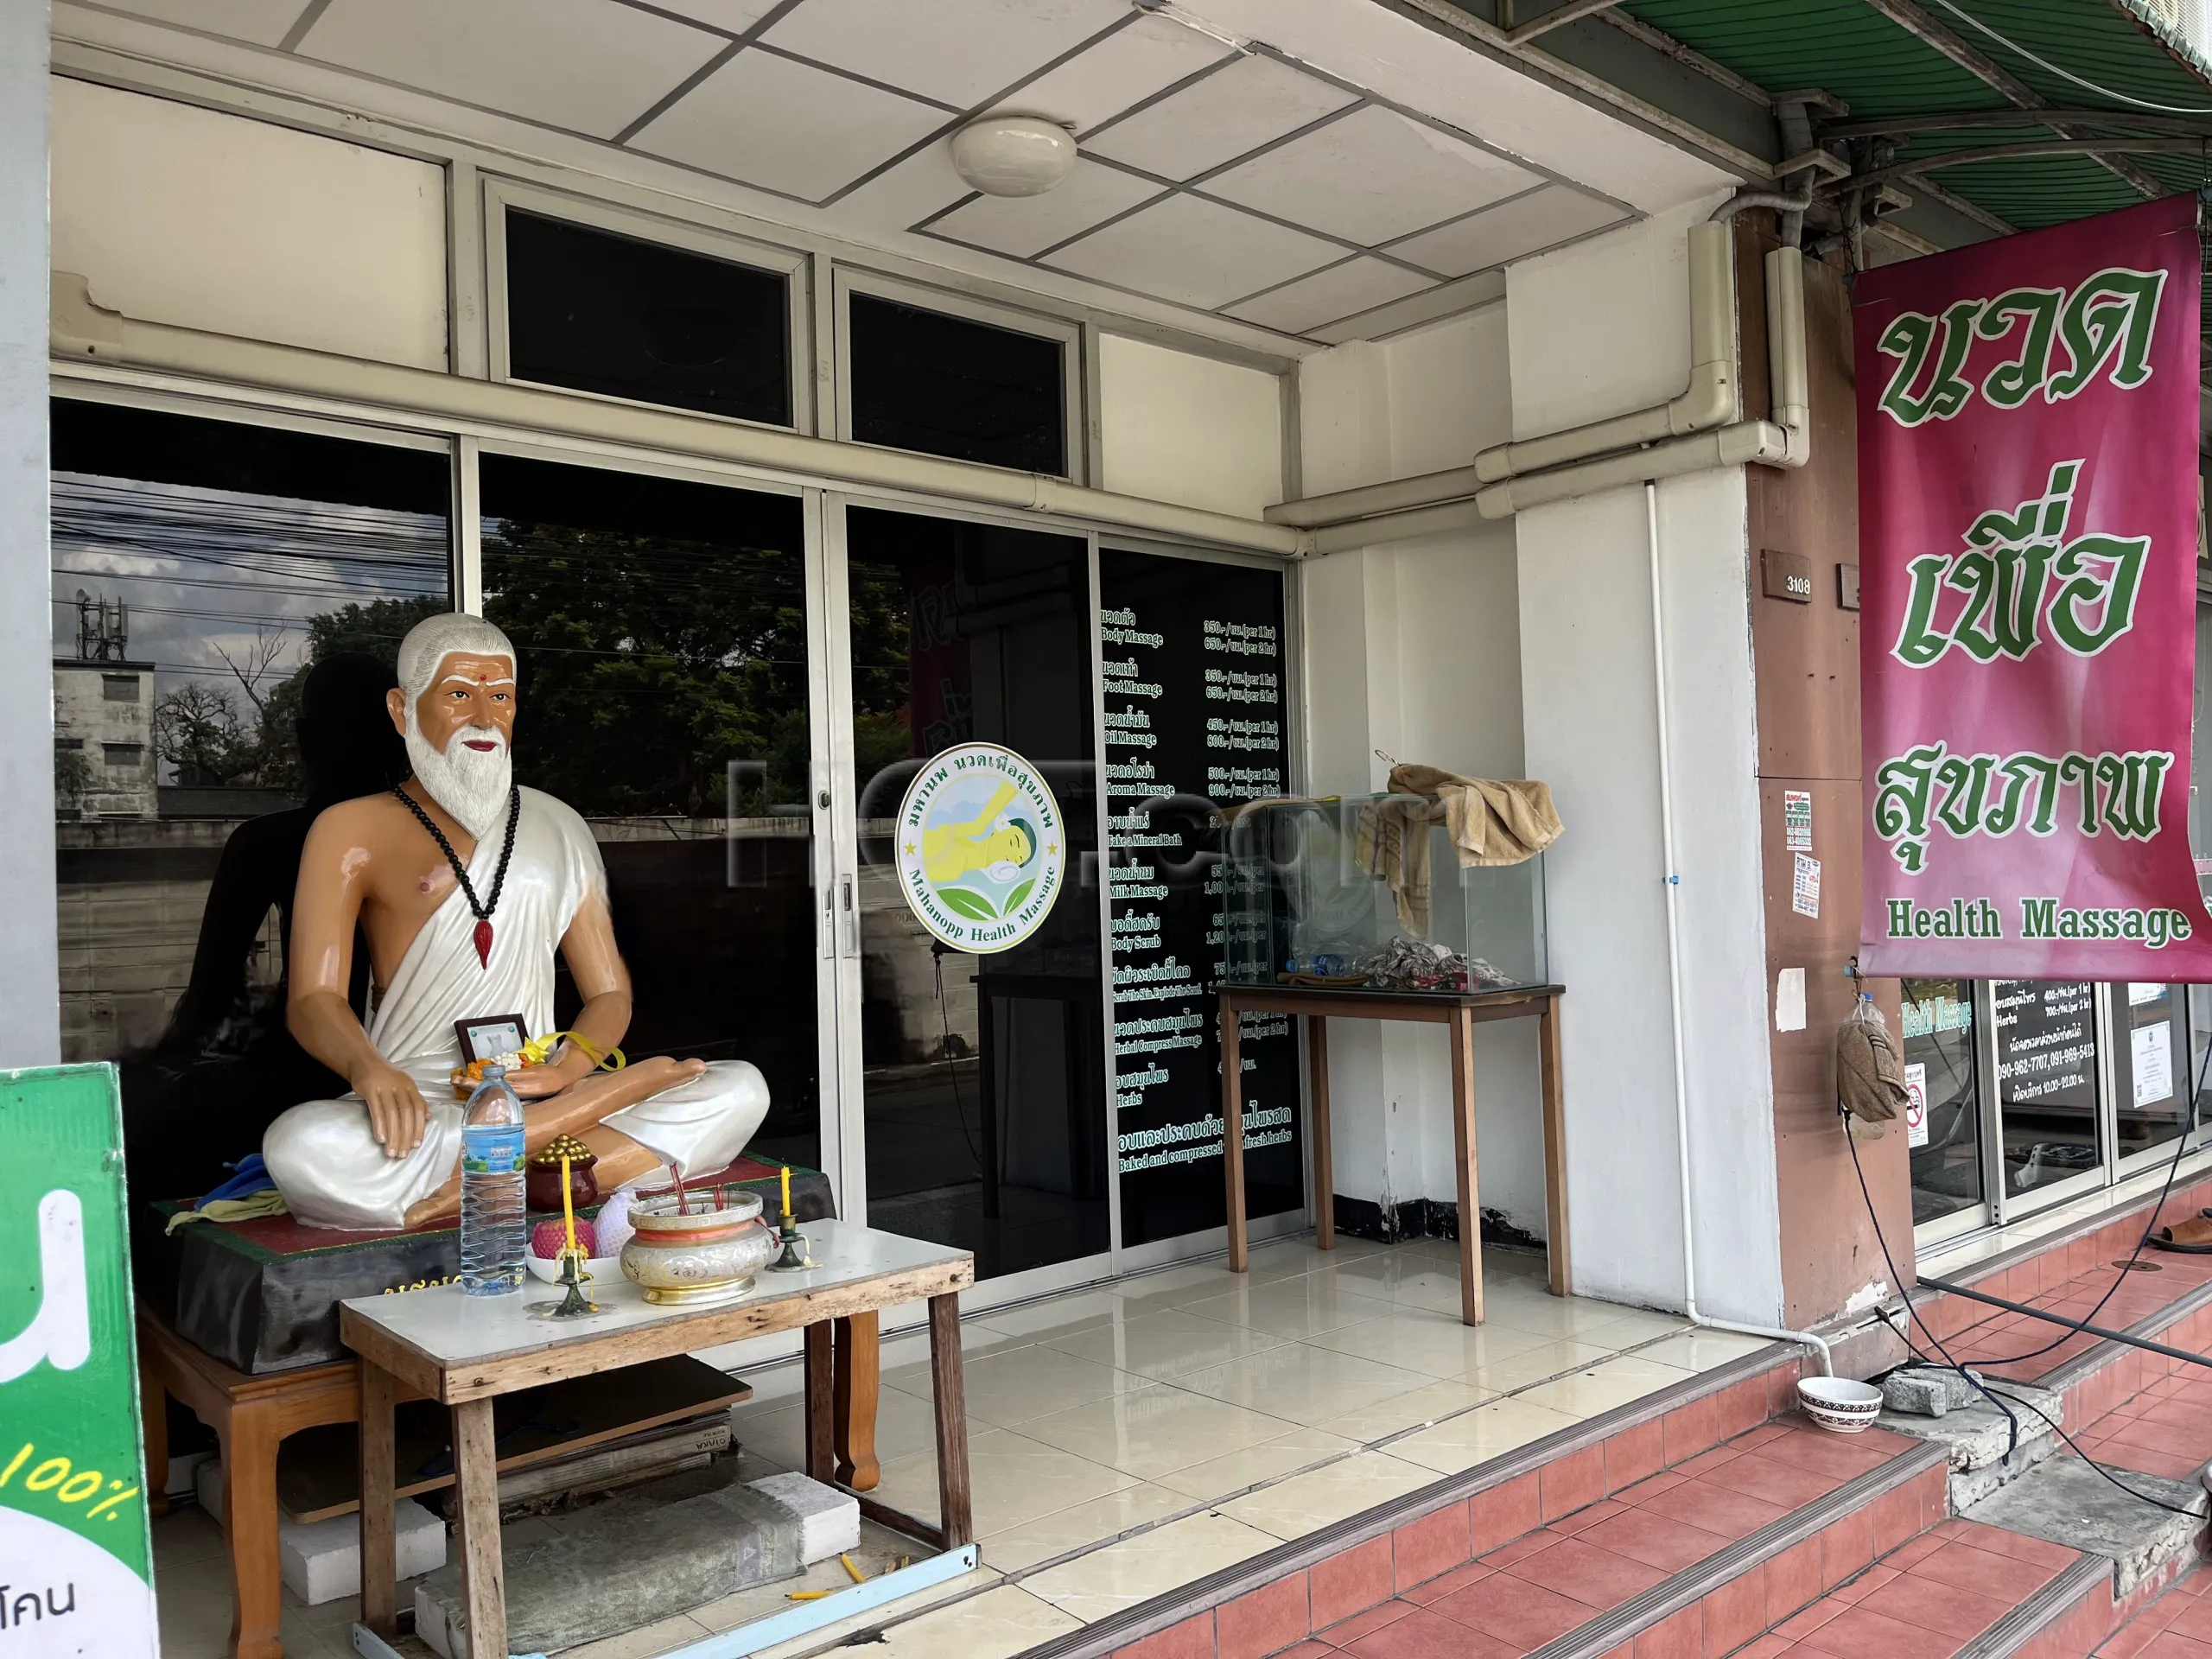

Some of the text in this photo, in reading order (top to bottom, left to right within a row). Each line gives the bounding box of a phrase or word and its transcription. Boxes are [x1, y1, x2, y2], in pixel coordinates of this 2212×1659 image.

[1877, 267, 2168, 429] นวด
[1890, 458, 2153, 669] เพื่อ
[1787, 575, 1811, 594] 3108
[1101, 607, 1135, 626] นวดตัว
[1101, 627, 1163, 649] Body Massage
[1103, 657, 1138, 677] นวดเท้า
[1103, 679, 1163, 699] Foot Massage
[1105, 730, 1157, 749] Oil Massage
[908, 754, 1053, 829] มหานพ นวดเพื่อสุขภาพ
[1106, 782, 1175, 799] Aroma Massage
[1107, 806, 1150, 830] อาบน้ำแร่
[1872, 740, 2175, 876] สุขภาพ
[1108, 833, 1182, 847] Take a Mineral Bath
[1109, 884, 1168, 900] Milk Massage
[909, 866, 1055, 942] Mahanopp Health Massage
[1886, 897, 2193, 949] Health Massage
[1111, 933, 1161, 953] Body Scrub
[1902, 996, 1972, 1039] Health Massage
[1997, 1012, 2018, 1027] Herbs
[1115, 1034, 1203, 1056] Herbal Compress Massage
[1116, 1062, 1169, 1090] อบสมุนไพร
[1116, 1091, 1142, 1108] Herbs
[1118, 1154, 1148, 1173] Baked
[1148, 1149, 1169, 1166] and
[1168, 1141, 1223, 1164] compressed
[1244, 1131, 1268, 1149] fresh
[1268, 1128, 1292, 1145] herbs
[0, 1443, 140, 1521] 100%
